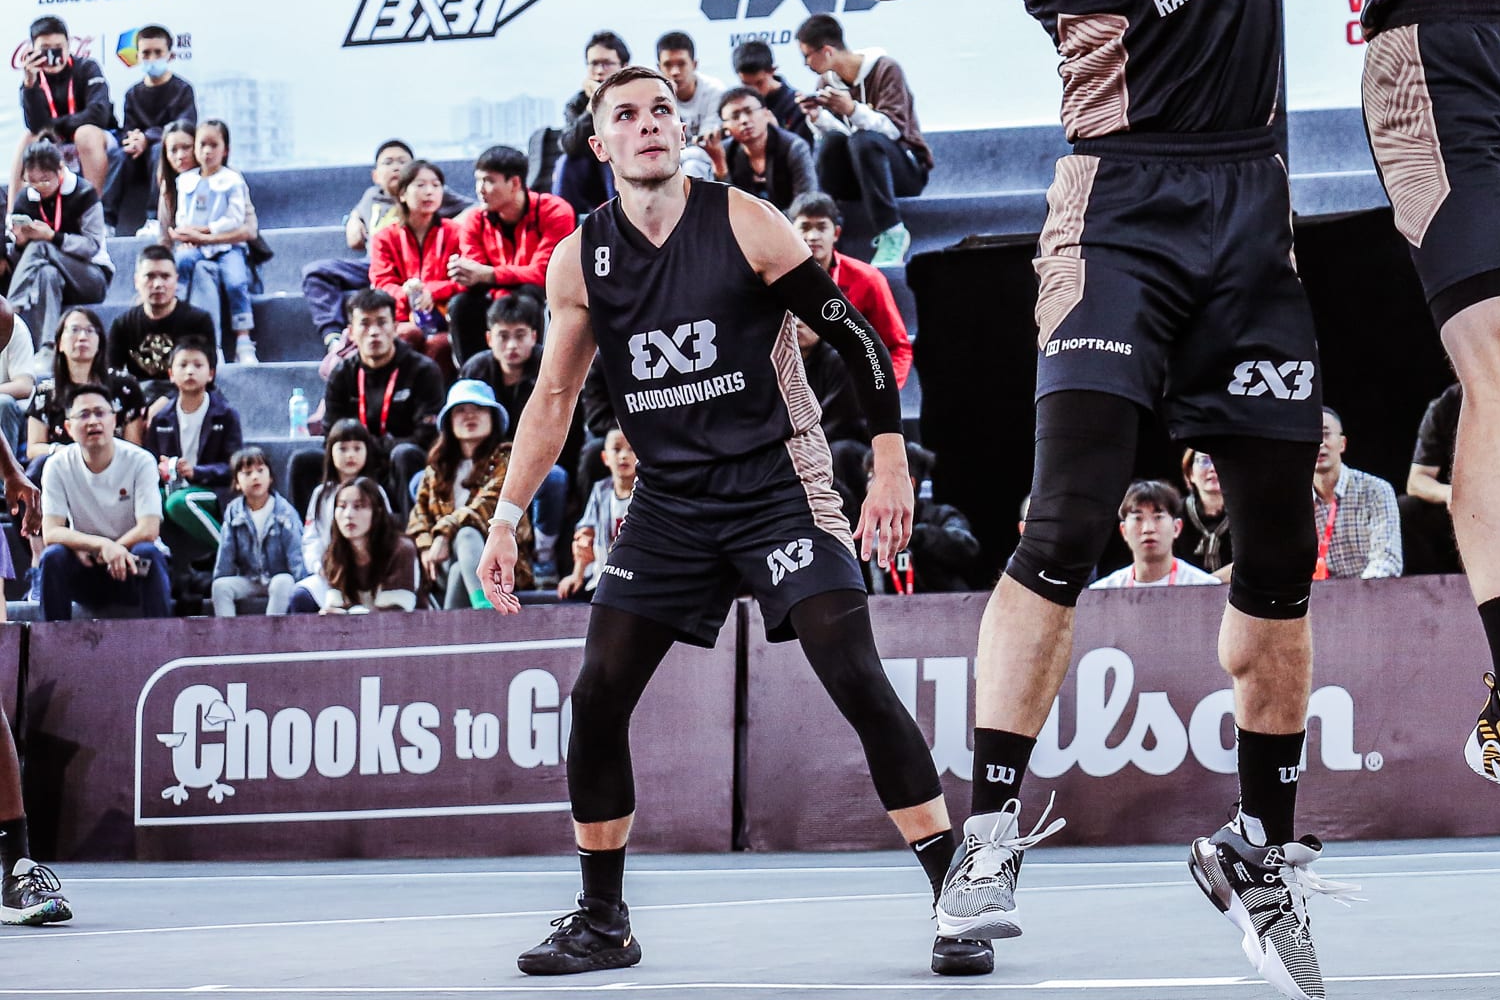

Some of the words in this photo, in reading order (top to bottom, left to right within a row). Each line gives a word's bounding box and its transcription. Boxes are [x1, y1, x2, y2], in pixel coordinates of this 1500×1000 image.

[594, 246, 611, 277] 8
[843, 317, 886, 391] nordorthopaedics
[1061, 338, 1133, 356] HOPTRANS
[624, 371, 746, 414] RAUDONDVARIS
[171, 676, 441, 789] Chooks
[453, 708, 500, 760] to
[507, 668, 572, 769] G
